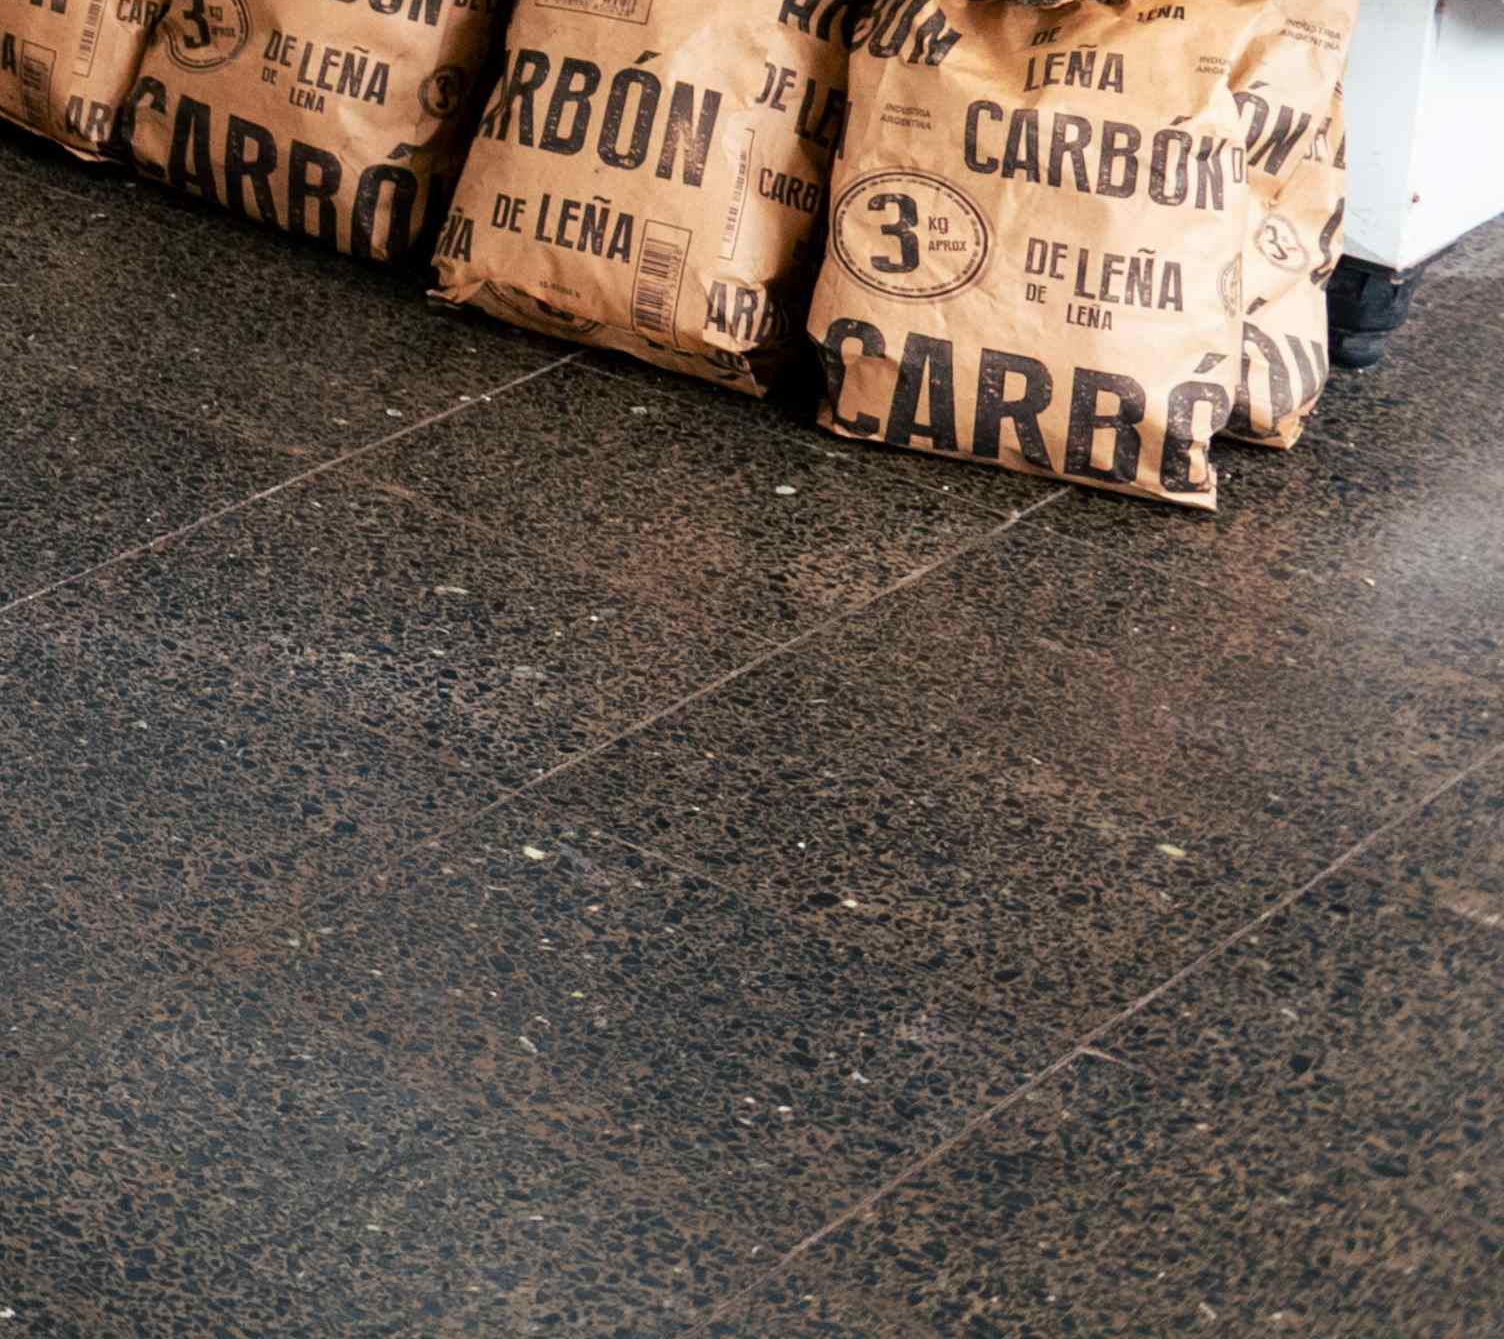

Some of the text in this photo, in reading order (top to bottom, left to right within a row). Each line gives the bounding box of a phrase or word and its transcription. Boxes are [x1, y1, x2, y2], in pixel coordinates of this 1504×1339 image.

[261, 66, 326, 115] DE LEÑA
[263, 29, 391, 106] DE LEÑA
[1023, 44, 1125, 94] LEÑA
[964, 100, 1227, 212] CARBÓN
[491, 192, 635, 264] DE LEÑA
[867, 191, 920, 274] 3
[928, 239, 968, 253] APROX
[1024, 236, 1185, 313] DE LEÑA
[1025, 282, 1114, 333] DE LEÑA
